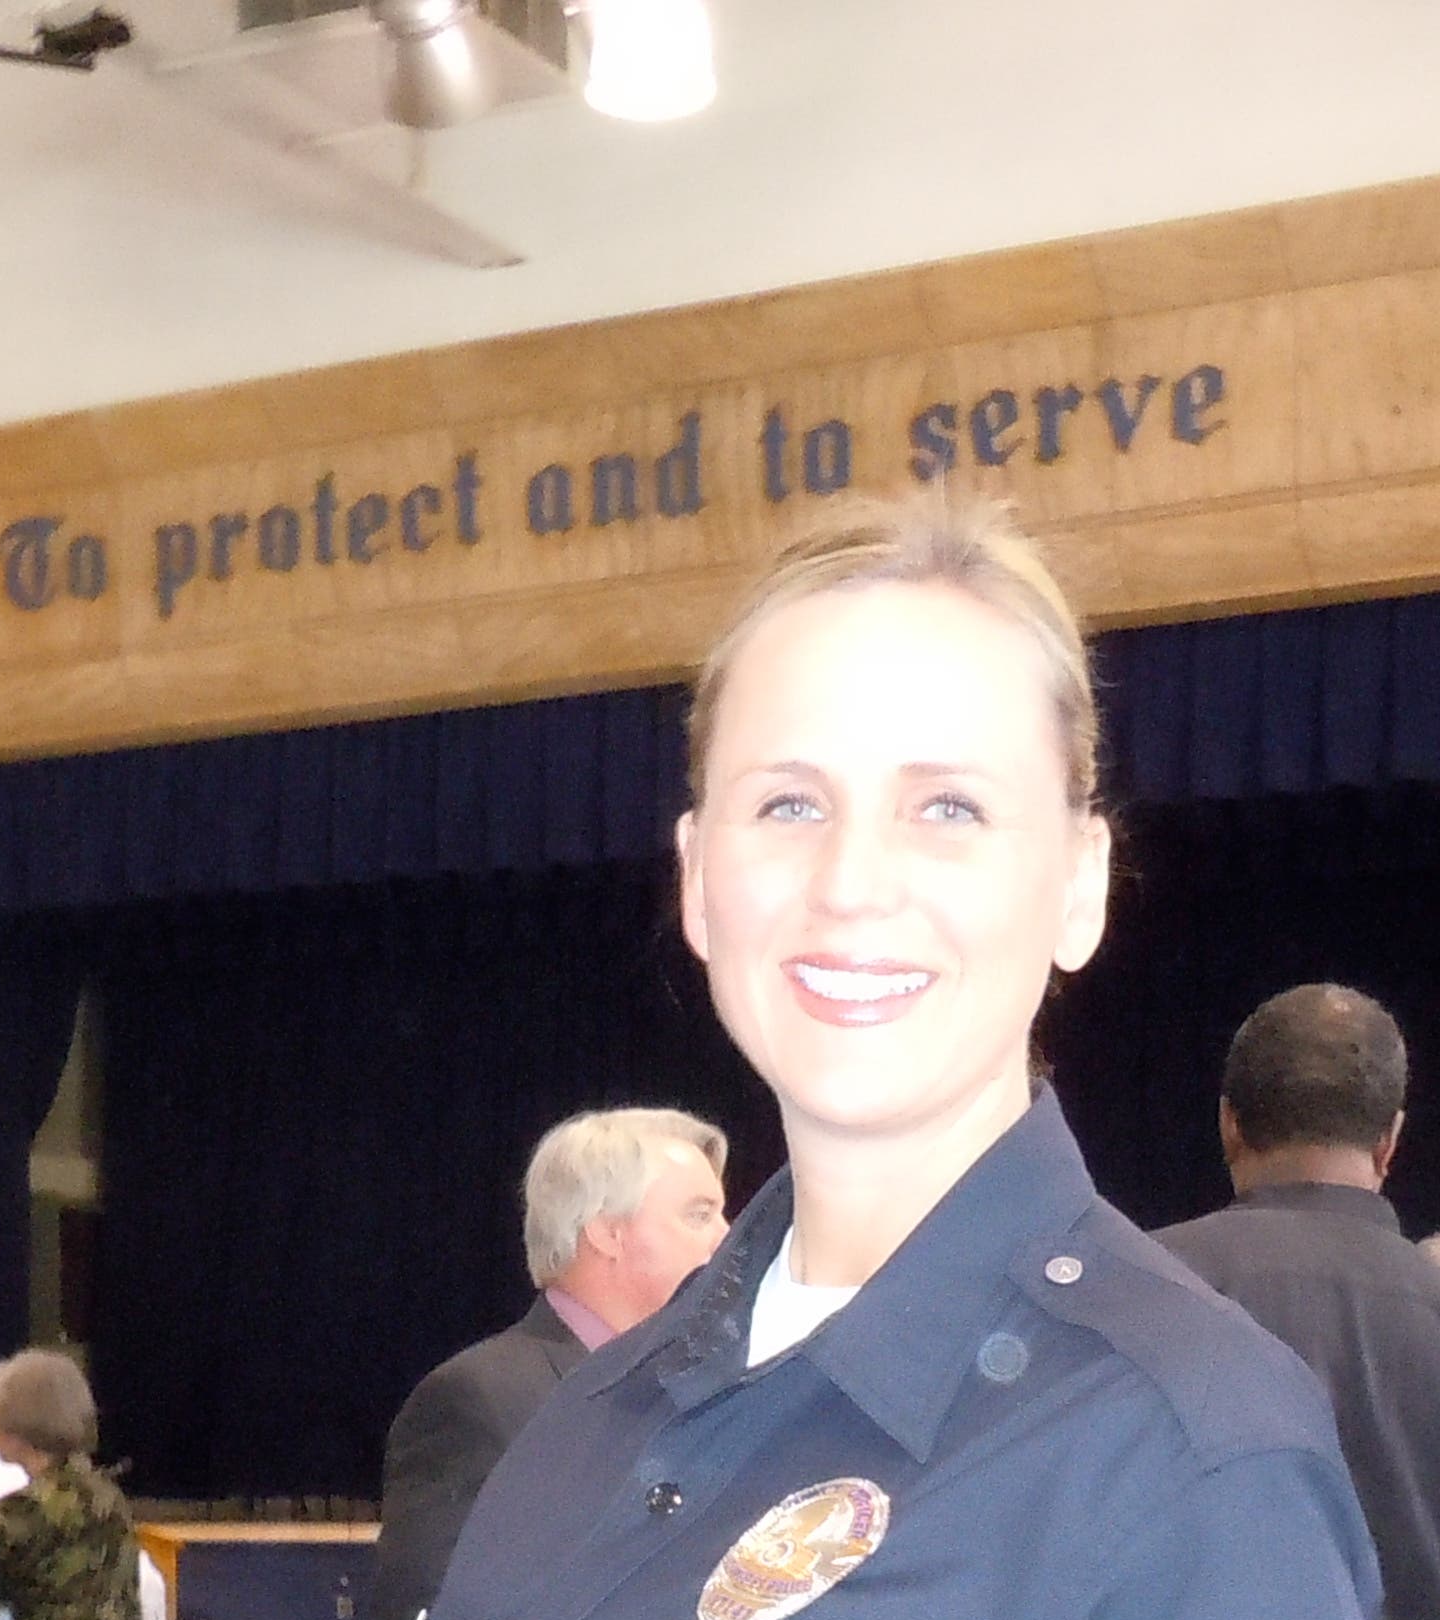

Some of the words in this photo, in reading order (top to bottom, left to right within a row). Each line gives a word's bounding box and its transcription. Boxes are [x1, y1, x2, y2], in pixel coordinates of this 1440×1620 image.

[155, 448, 482, 620] protect
[526, 410, 702, 536] and
[759, 404, 853, 502] to
[907, 364, 1226, 482] serve
